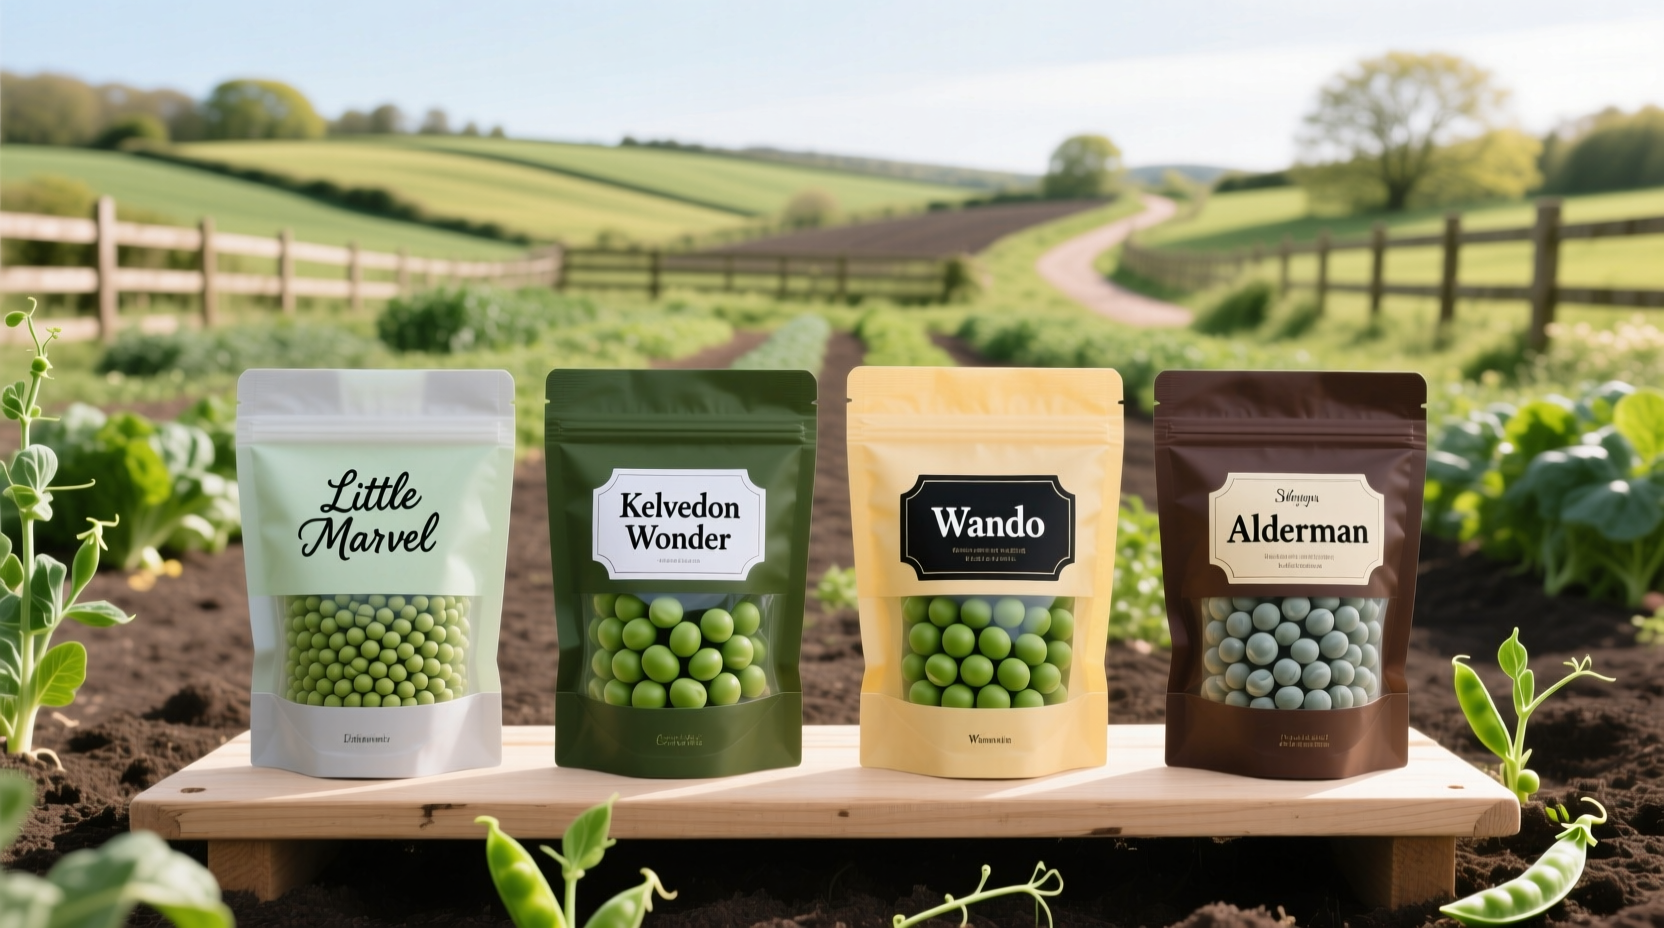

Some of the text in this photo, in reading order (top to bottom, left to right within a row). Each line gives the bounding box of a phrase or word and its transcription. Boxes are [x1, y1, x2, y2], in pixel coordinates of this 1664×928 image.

[320, 469, 422, 513] Little
[619, 492, 740, 519] Kelvedon
[298, 511, 440, 561] Marvel
[625, 523, 731, 550] Wonder
[931, 505, 1045, 538] Wando
[1227, 513, 1369, 544] Alderman
